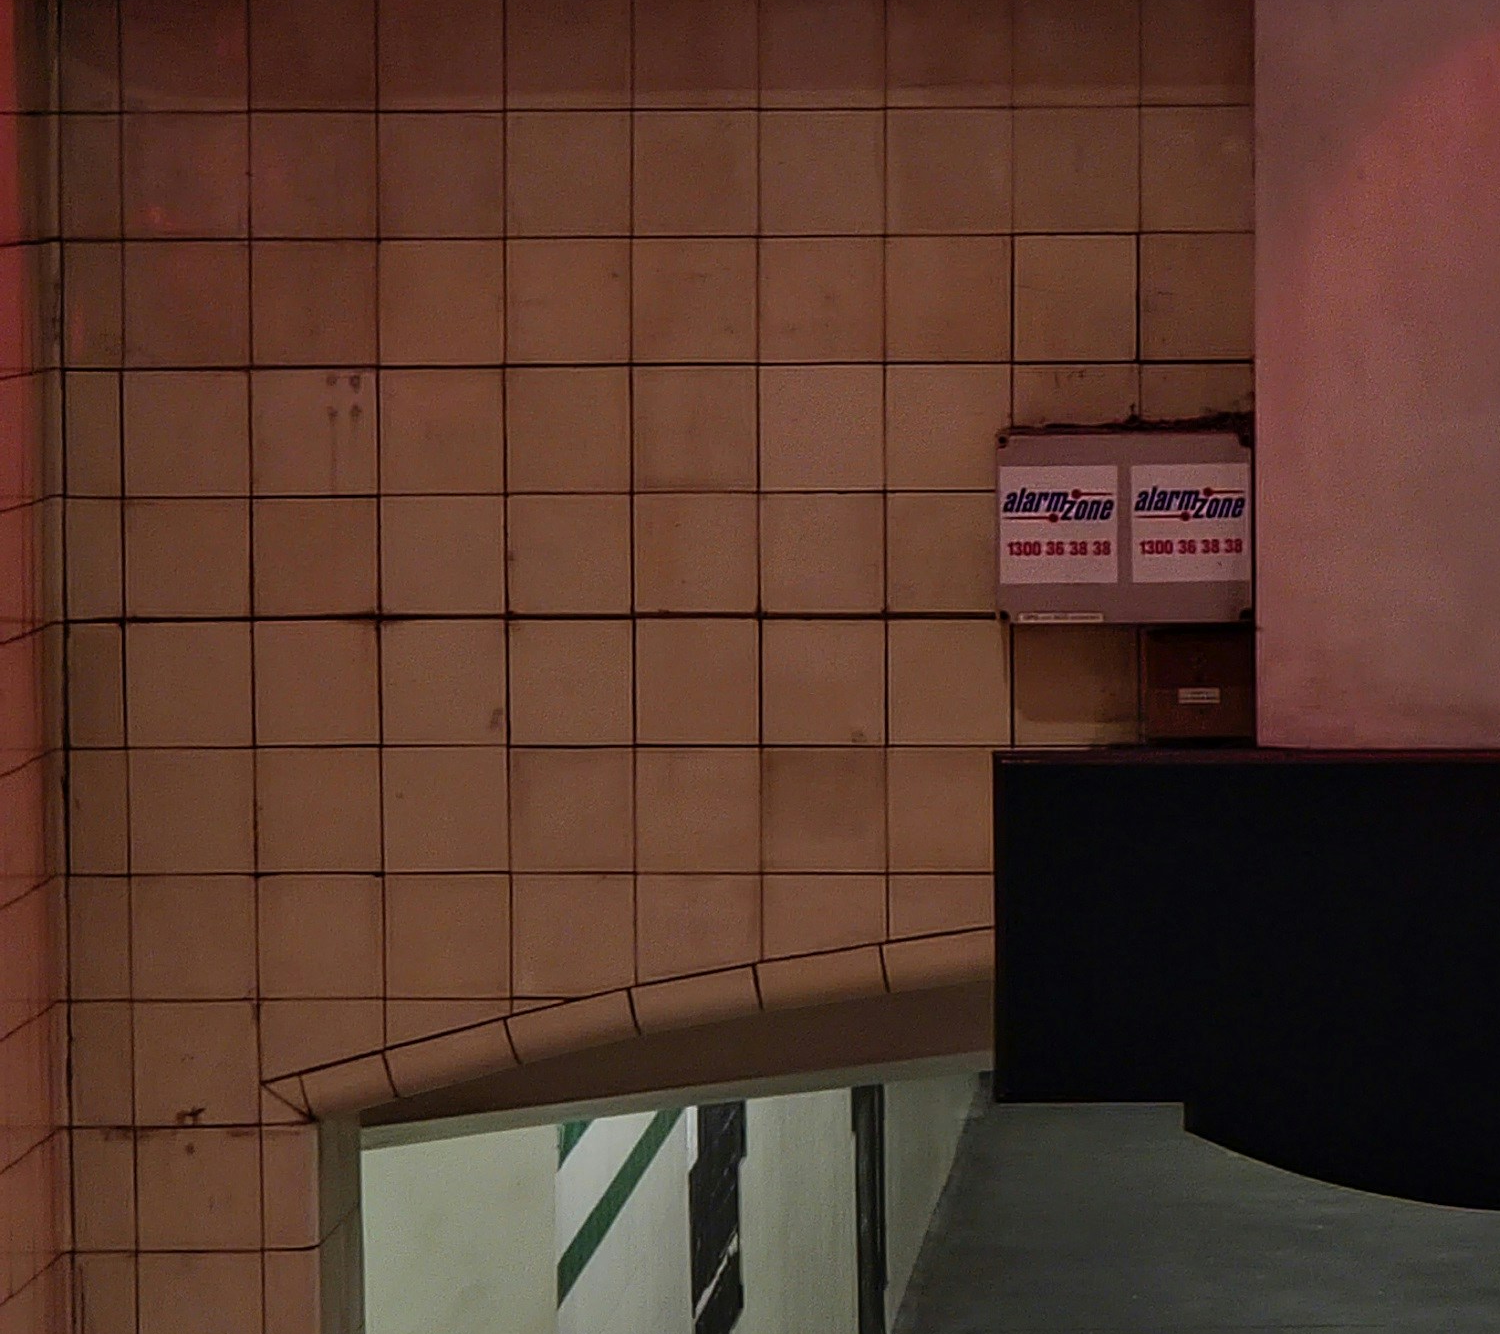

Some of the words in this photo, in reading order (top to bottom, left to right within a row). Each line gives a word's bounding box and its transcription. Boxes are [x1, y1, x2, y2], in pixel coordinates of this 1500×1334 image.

[1003, 487, 1114, 521] alarmzone
[1134, 485, 1246, 519] alarmzone
[1007, 540, 1042, 557] 1300
[1046, 540, 1065, 556] 36
[1069, 540, 1088, 556] 38
[1092, 540, 1112, 556] 38
[1139, 539, 1174, 555] 1300
[1177, 539, 1197, 554] 36
[1201, 538, 1220, 554] 38
[1224, 538, 1243, 553] 38
